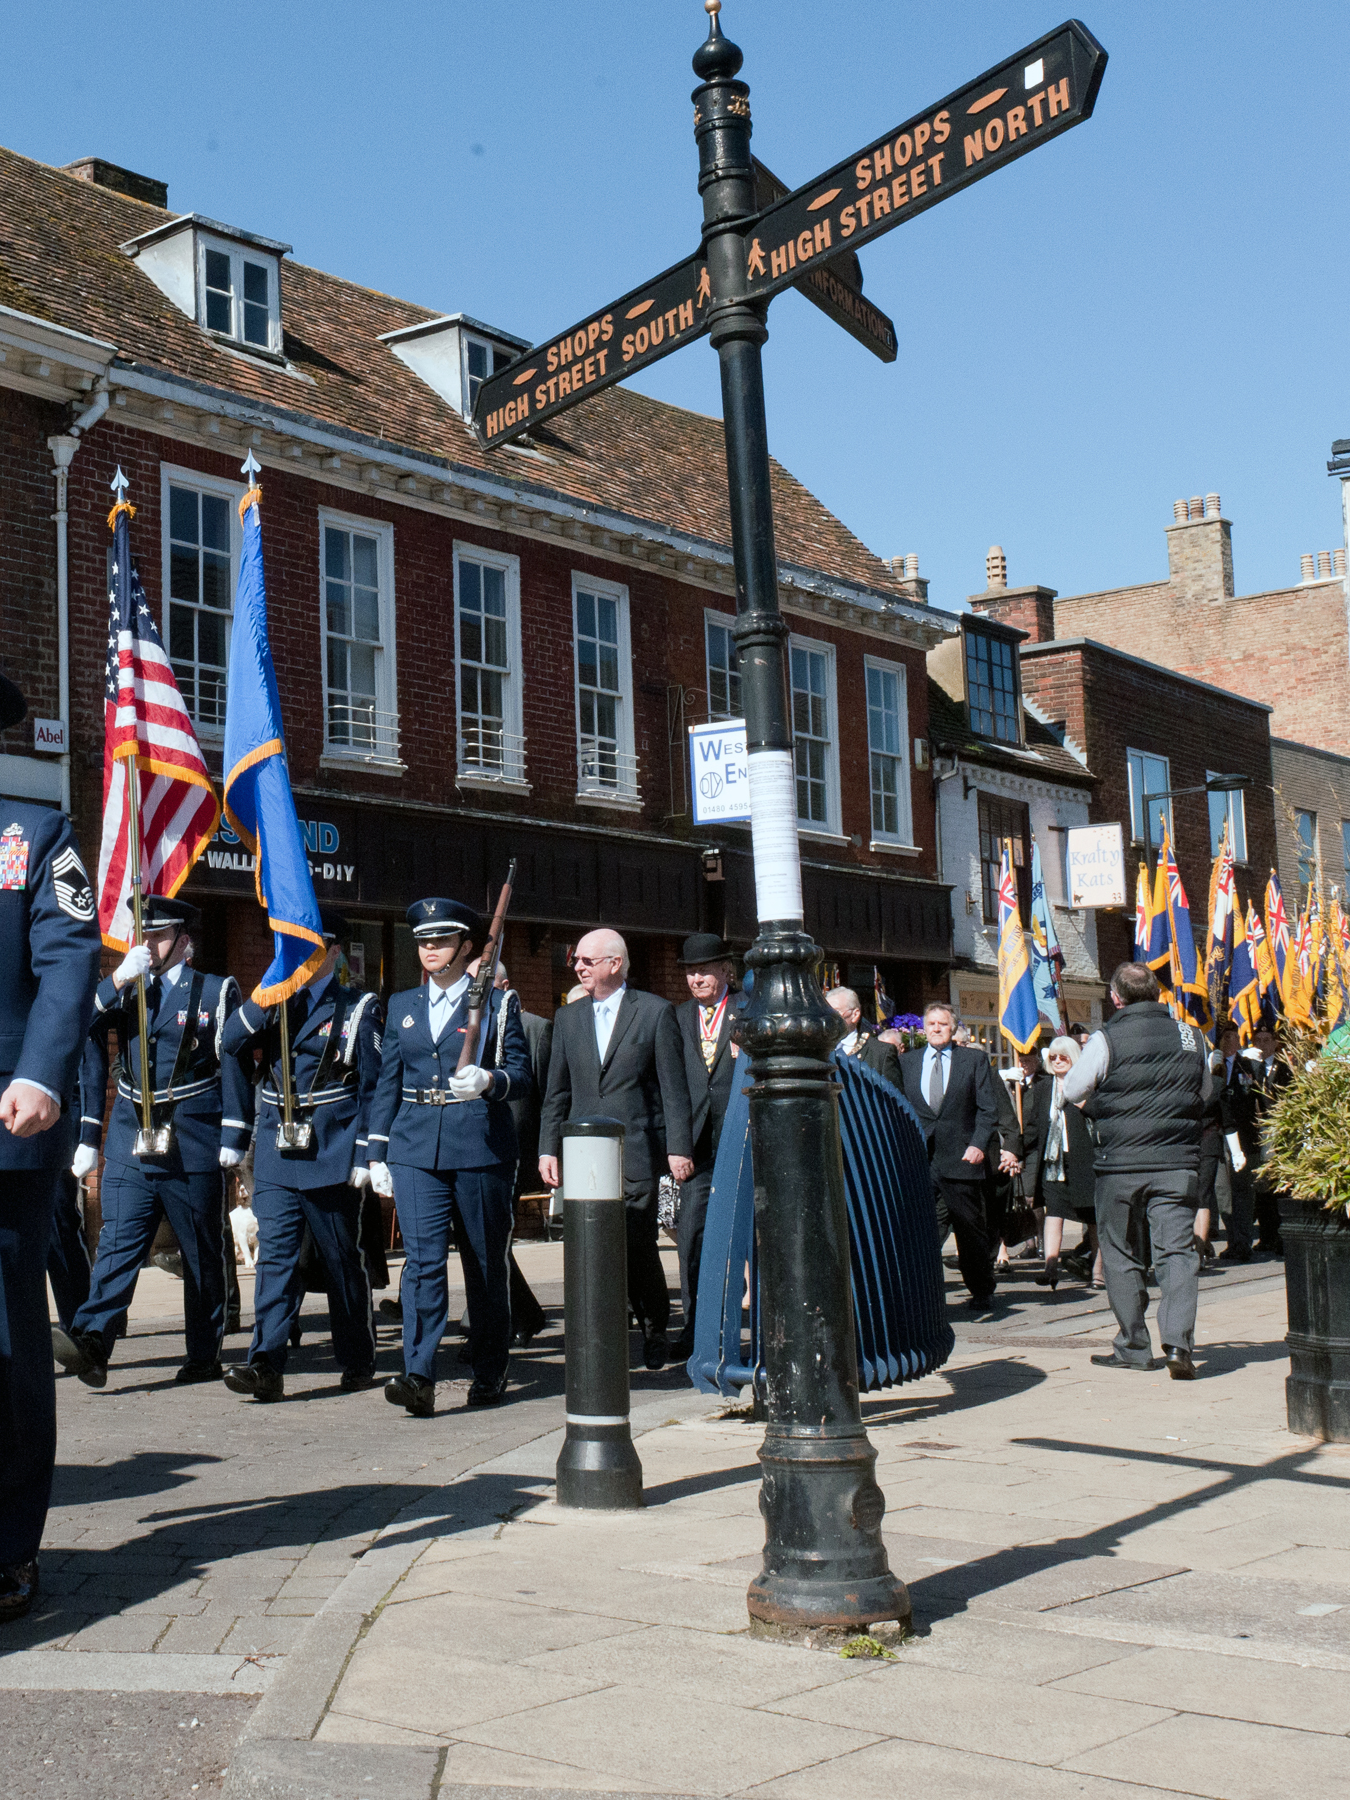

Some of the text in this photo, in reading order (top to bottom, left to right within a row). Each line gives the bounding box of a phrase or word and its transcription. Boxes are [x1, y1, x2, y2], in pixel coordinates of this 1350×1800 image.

[855, 111, 950, 190] SHOPS
[771, 78, 1070, 279] HIGH STREET NORTH
[810, 269, 886, 343] INFORMATION
[547, 314, 614, 373] SHOPS
[486, 299, 694, 439] HIGH STREET SOUTH
[36, 726, 64, 745] Abel
[699, 739, 747, 762] WES
[725, 762, 748, 785] EN
[703, 802, 751, 814] 01480 4595
[298, 819, 340, 854] ND
[1070, 840, 1120, 867] Krafty
[1077, 873, 1114, 888] Kats
[1111, 892, 1122, 903] 33
[1003, 924, 1023, 954] BRITISH
